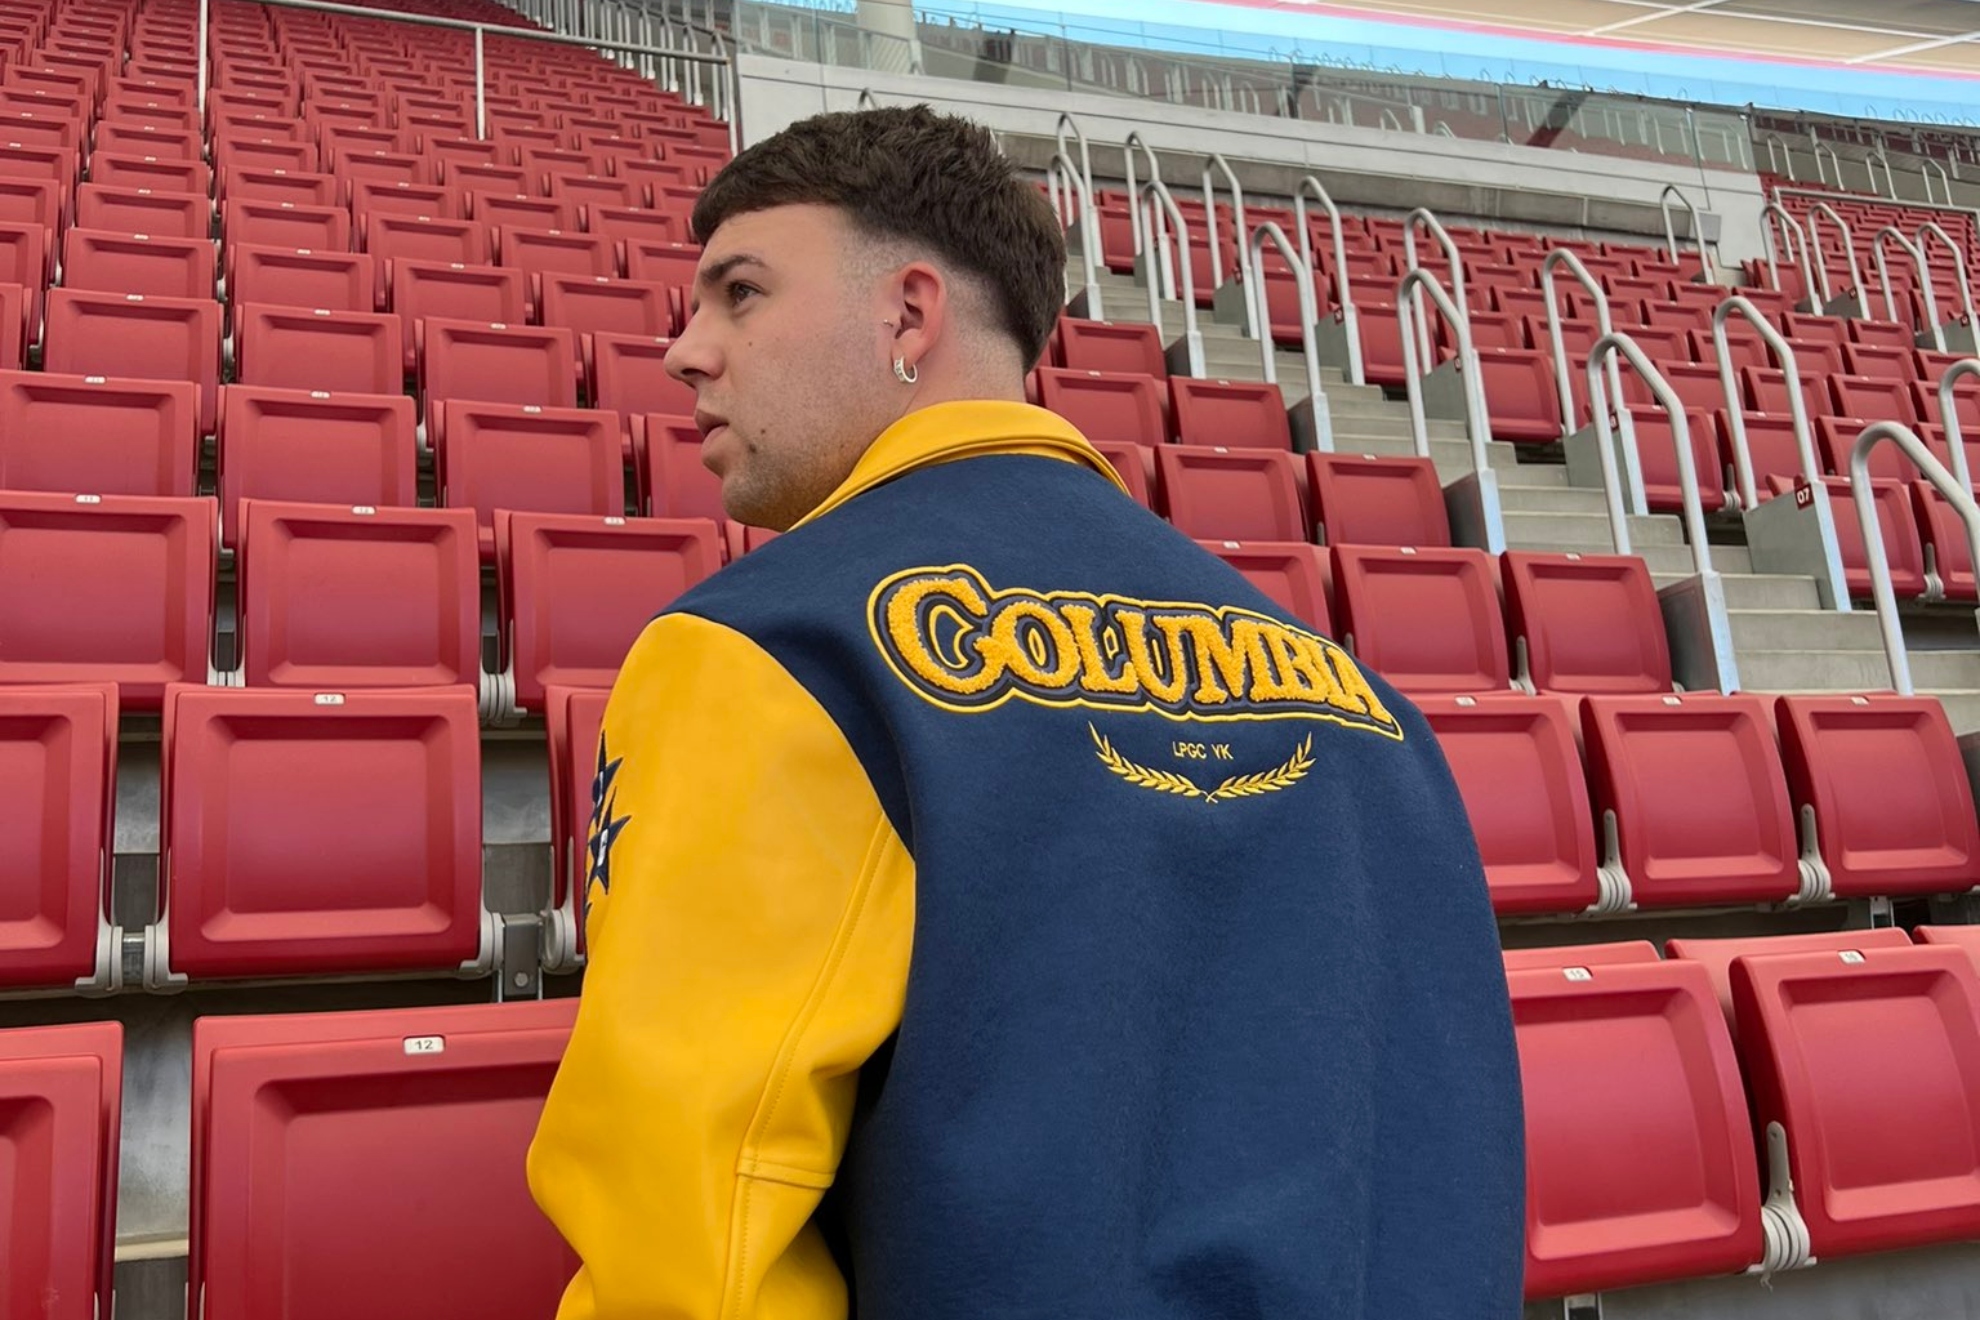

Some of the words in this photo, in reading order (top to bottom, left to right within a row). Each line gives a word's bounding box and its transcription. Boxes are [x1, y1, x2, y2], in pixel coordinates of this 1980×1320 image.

[1796, 487, 1809, 504] 07
[885, 576, 1393, 725] COLUMBIA
[1172, 741, 1207, 759] LPGC
[414, 1039, 434, 1051] 12
